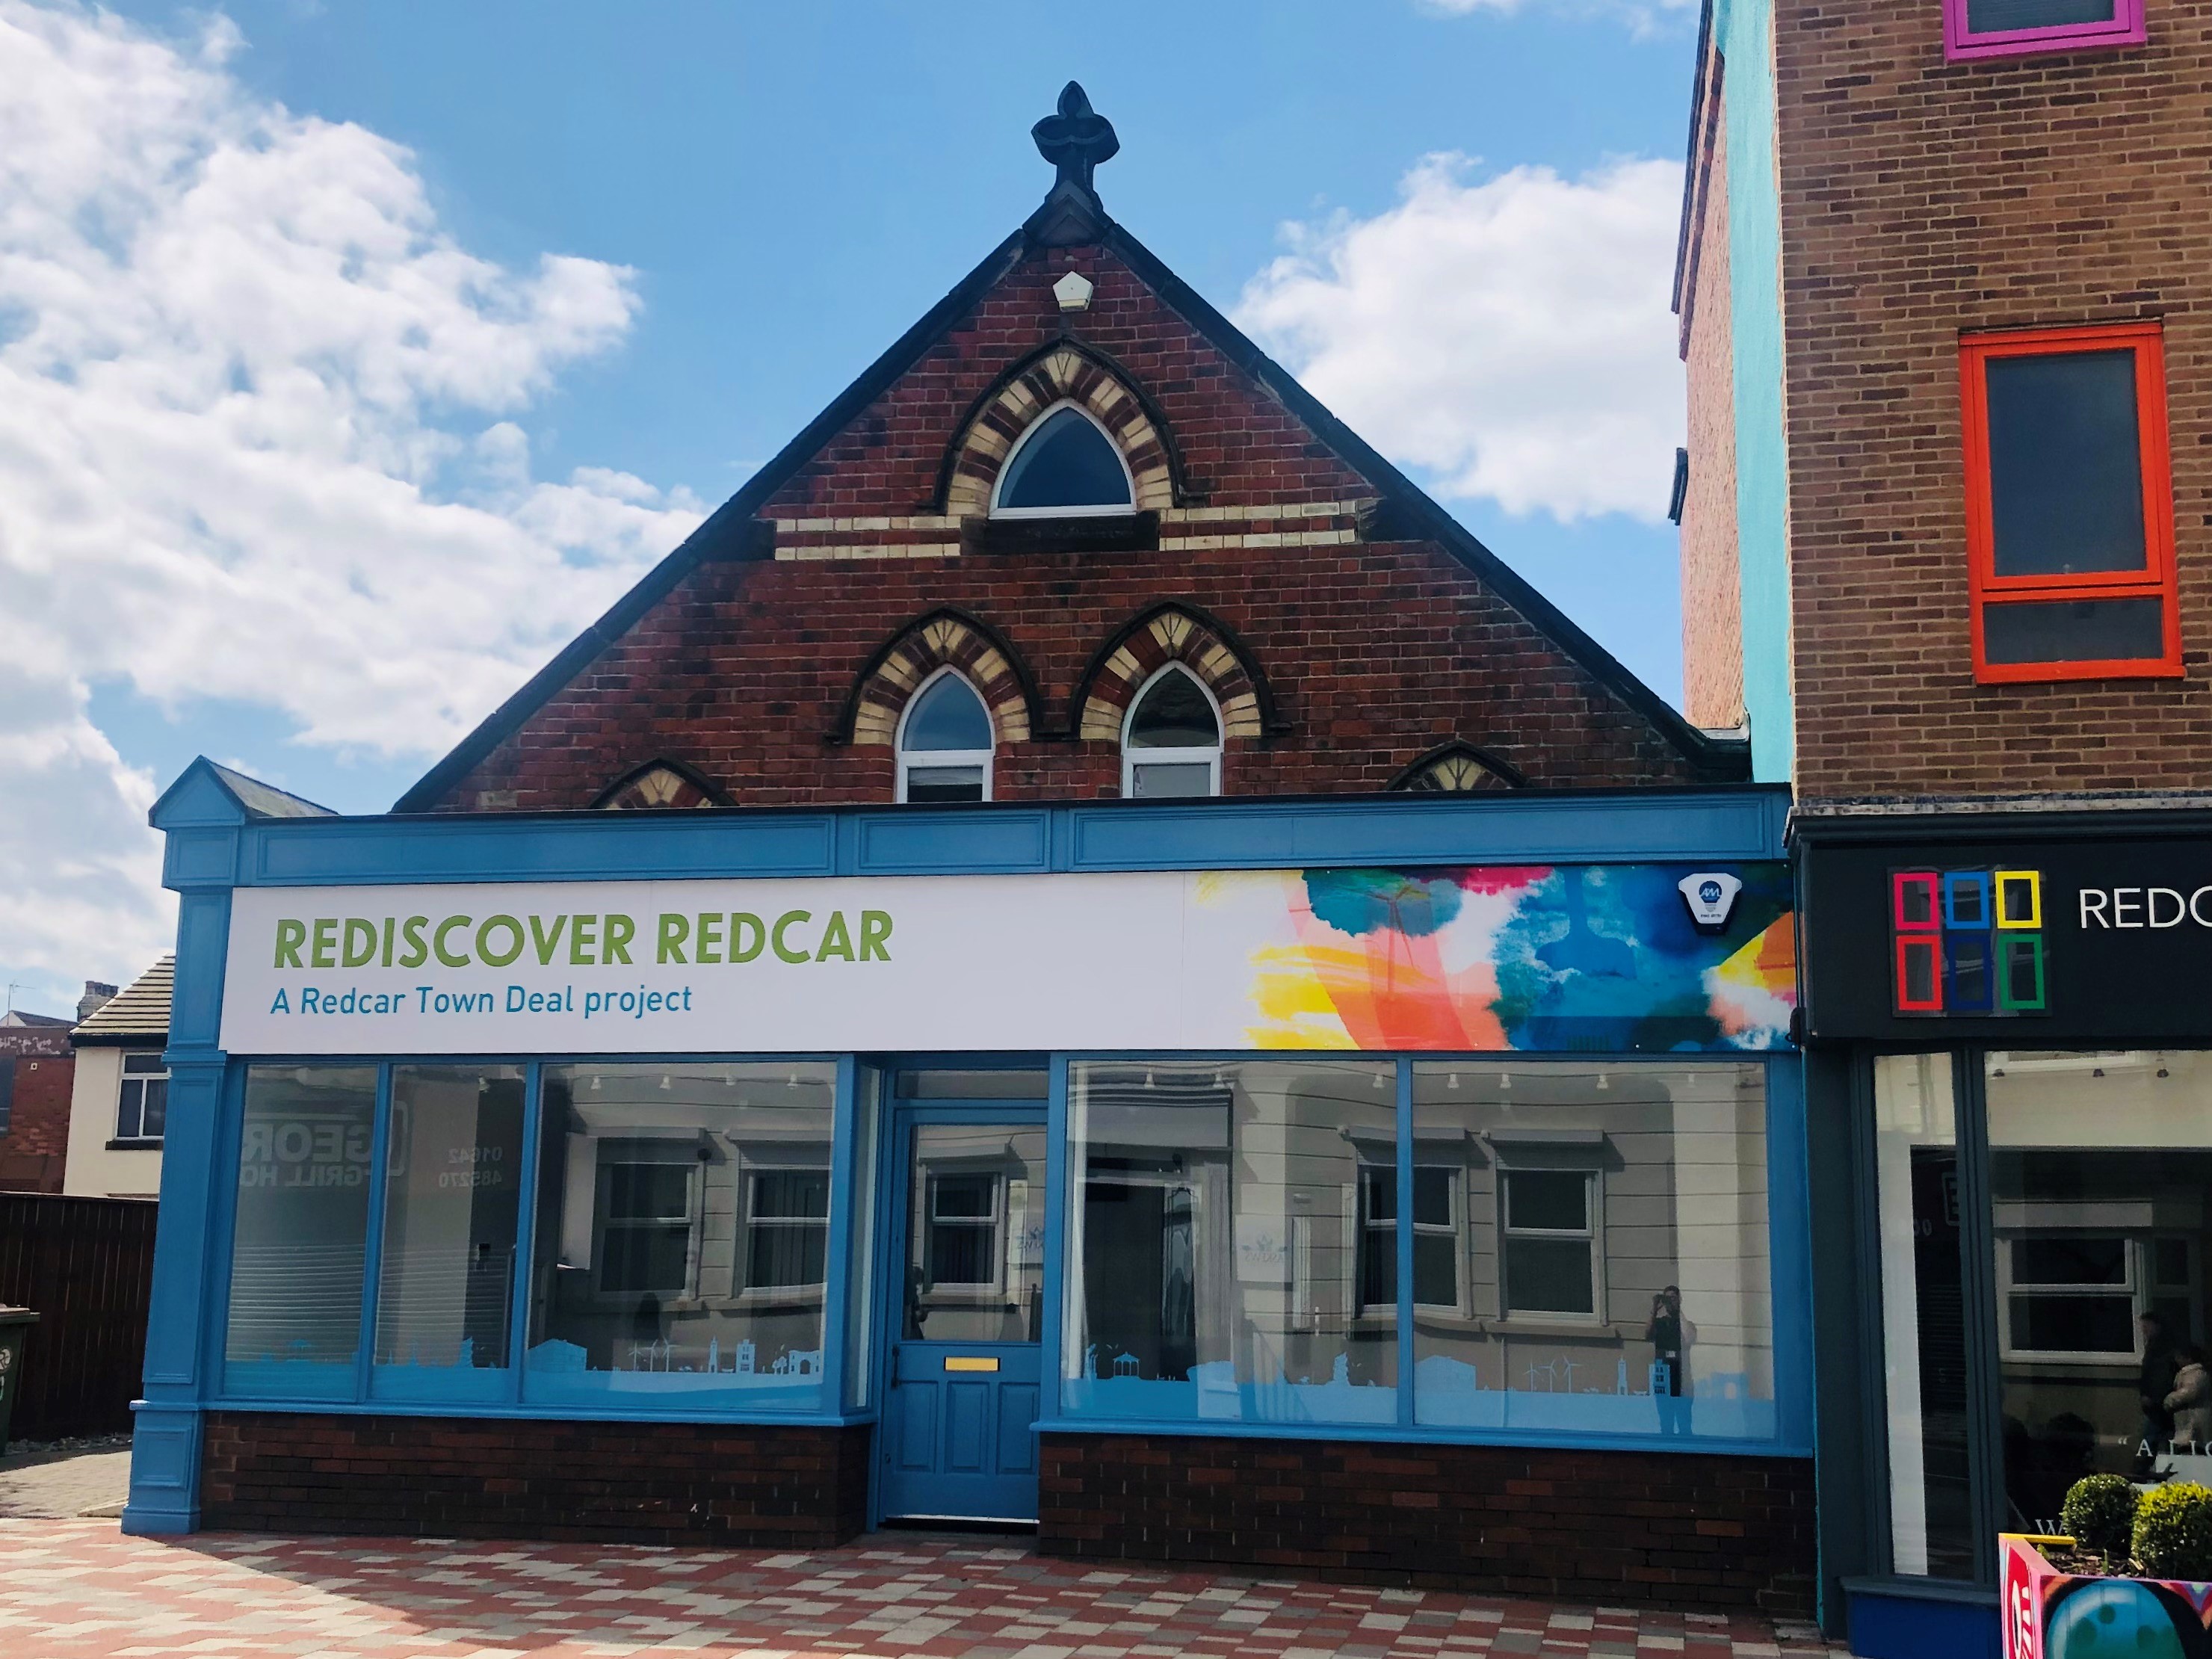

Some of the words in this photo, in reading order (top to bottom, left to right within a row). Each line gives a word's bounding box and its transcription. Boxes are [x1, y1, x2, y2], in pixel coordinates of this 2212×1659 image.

[274, 915, 635, 968] REDISCOVER
[656, 909, 894, 964] REDCAR
[270, 988, 291, 1015] A
[300, 987, 407, 1015] Redcar
[415, 986, 494, 1013] Town
[506, 985, 574, 1013] Deal
[584, 984, 692, 1019] project
